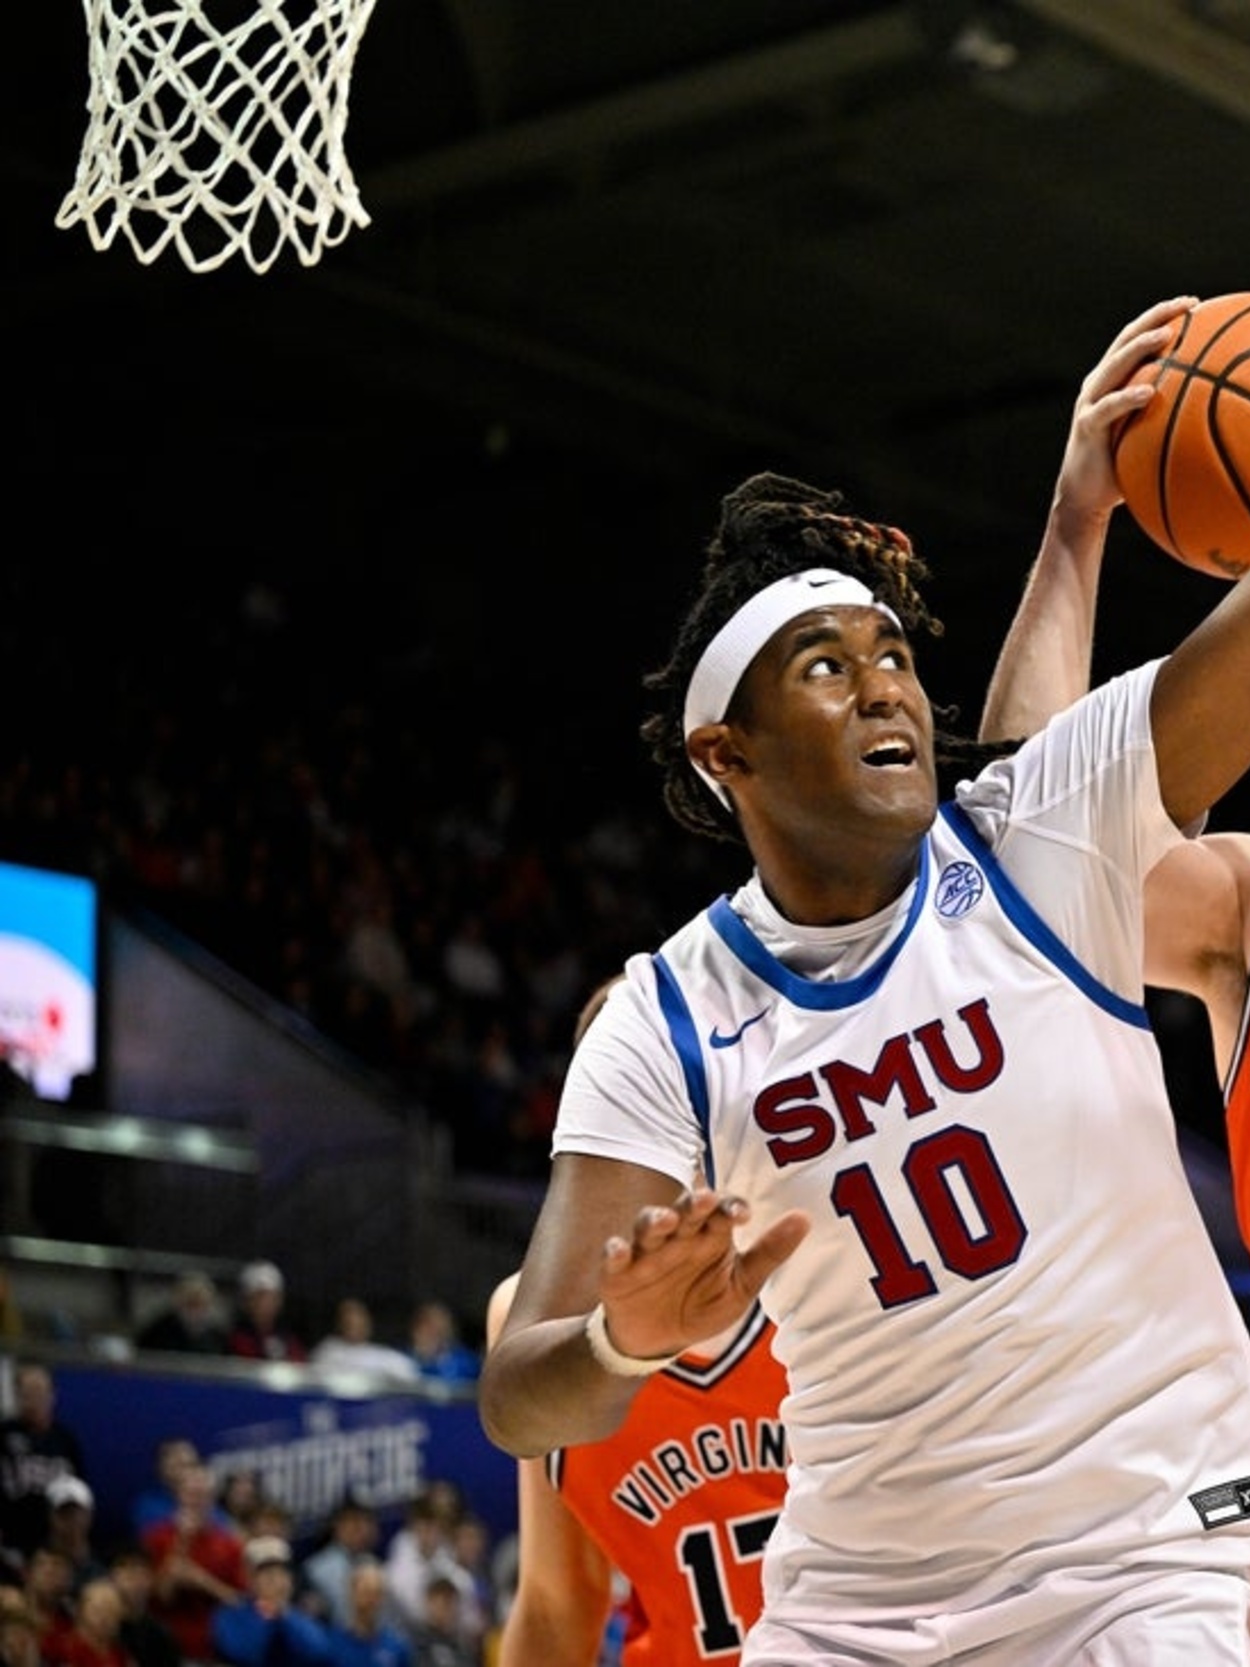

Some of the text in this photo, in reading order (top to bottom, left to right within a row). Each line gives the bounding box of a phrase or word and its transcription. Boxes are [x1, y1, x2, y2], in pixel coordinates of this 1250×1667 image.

[753, 997, 1004, 1169] SMU
[830, 1123, 1029, 1310] 10
[611, 1417, 789, 1527] VIRGIN
